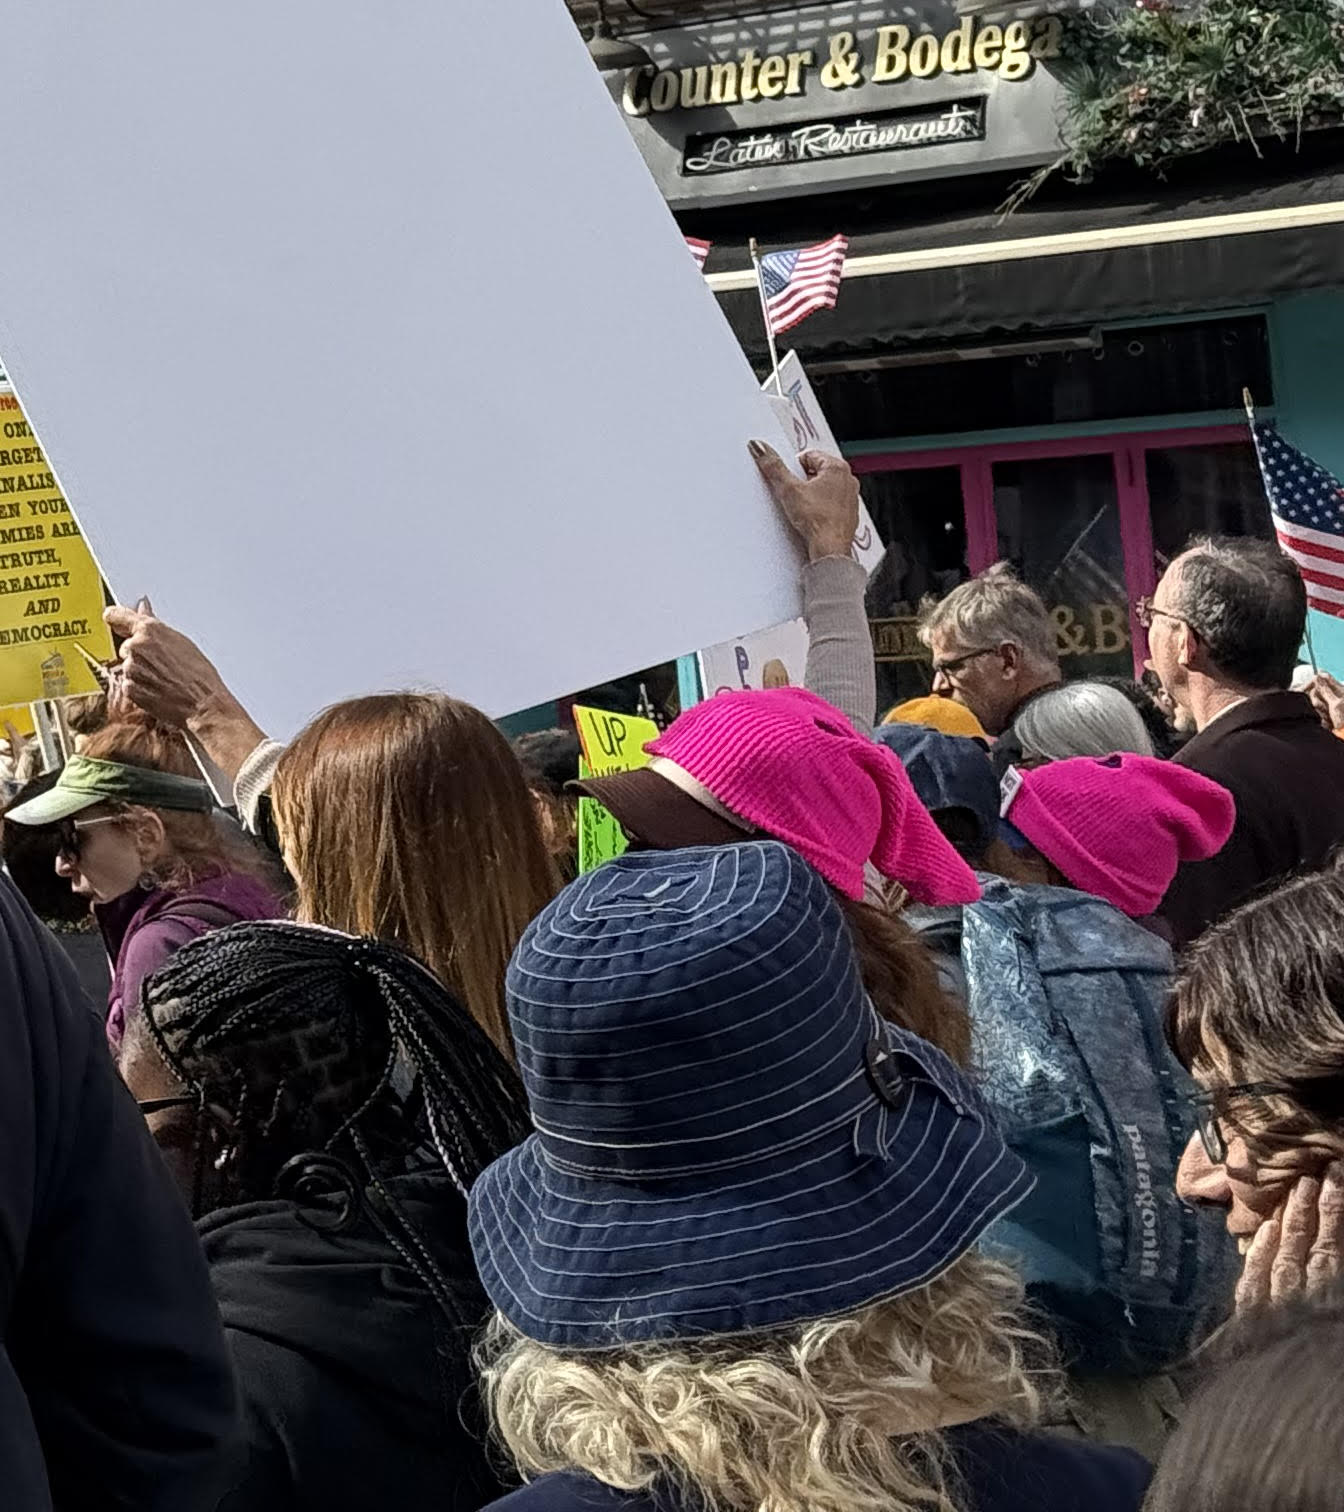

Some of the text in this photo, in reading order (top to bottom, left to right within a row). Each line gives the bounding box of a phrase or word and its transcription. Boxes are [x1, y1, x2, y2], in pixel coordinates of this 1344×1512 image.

[622, 15, 1060, 115] Counter & Bodega
[796, 105, 976, 158] Restaurant
[24, 597, 61, 617] AND
[589, 712, 627, 757] UP
[1121, 1124, 1161, 1278] patagonia
